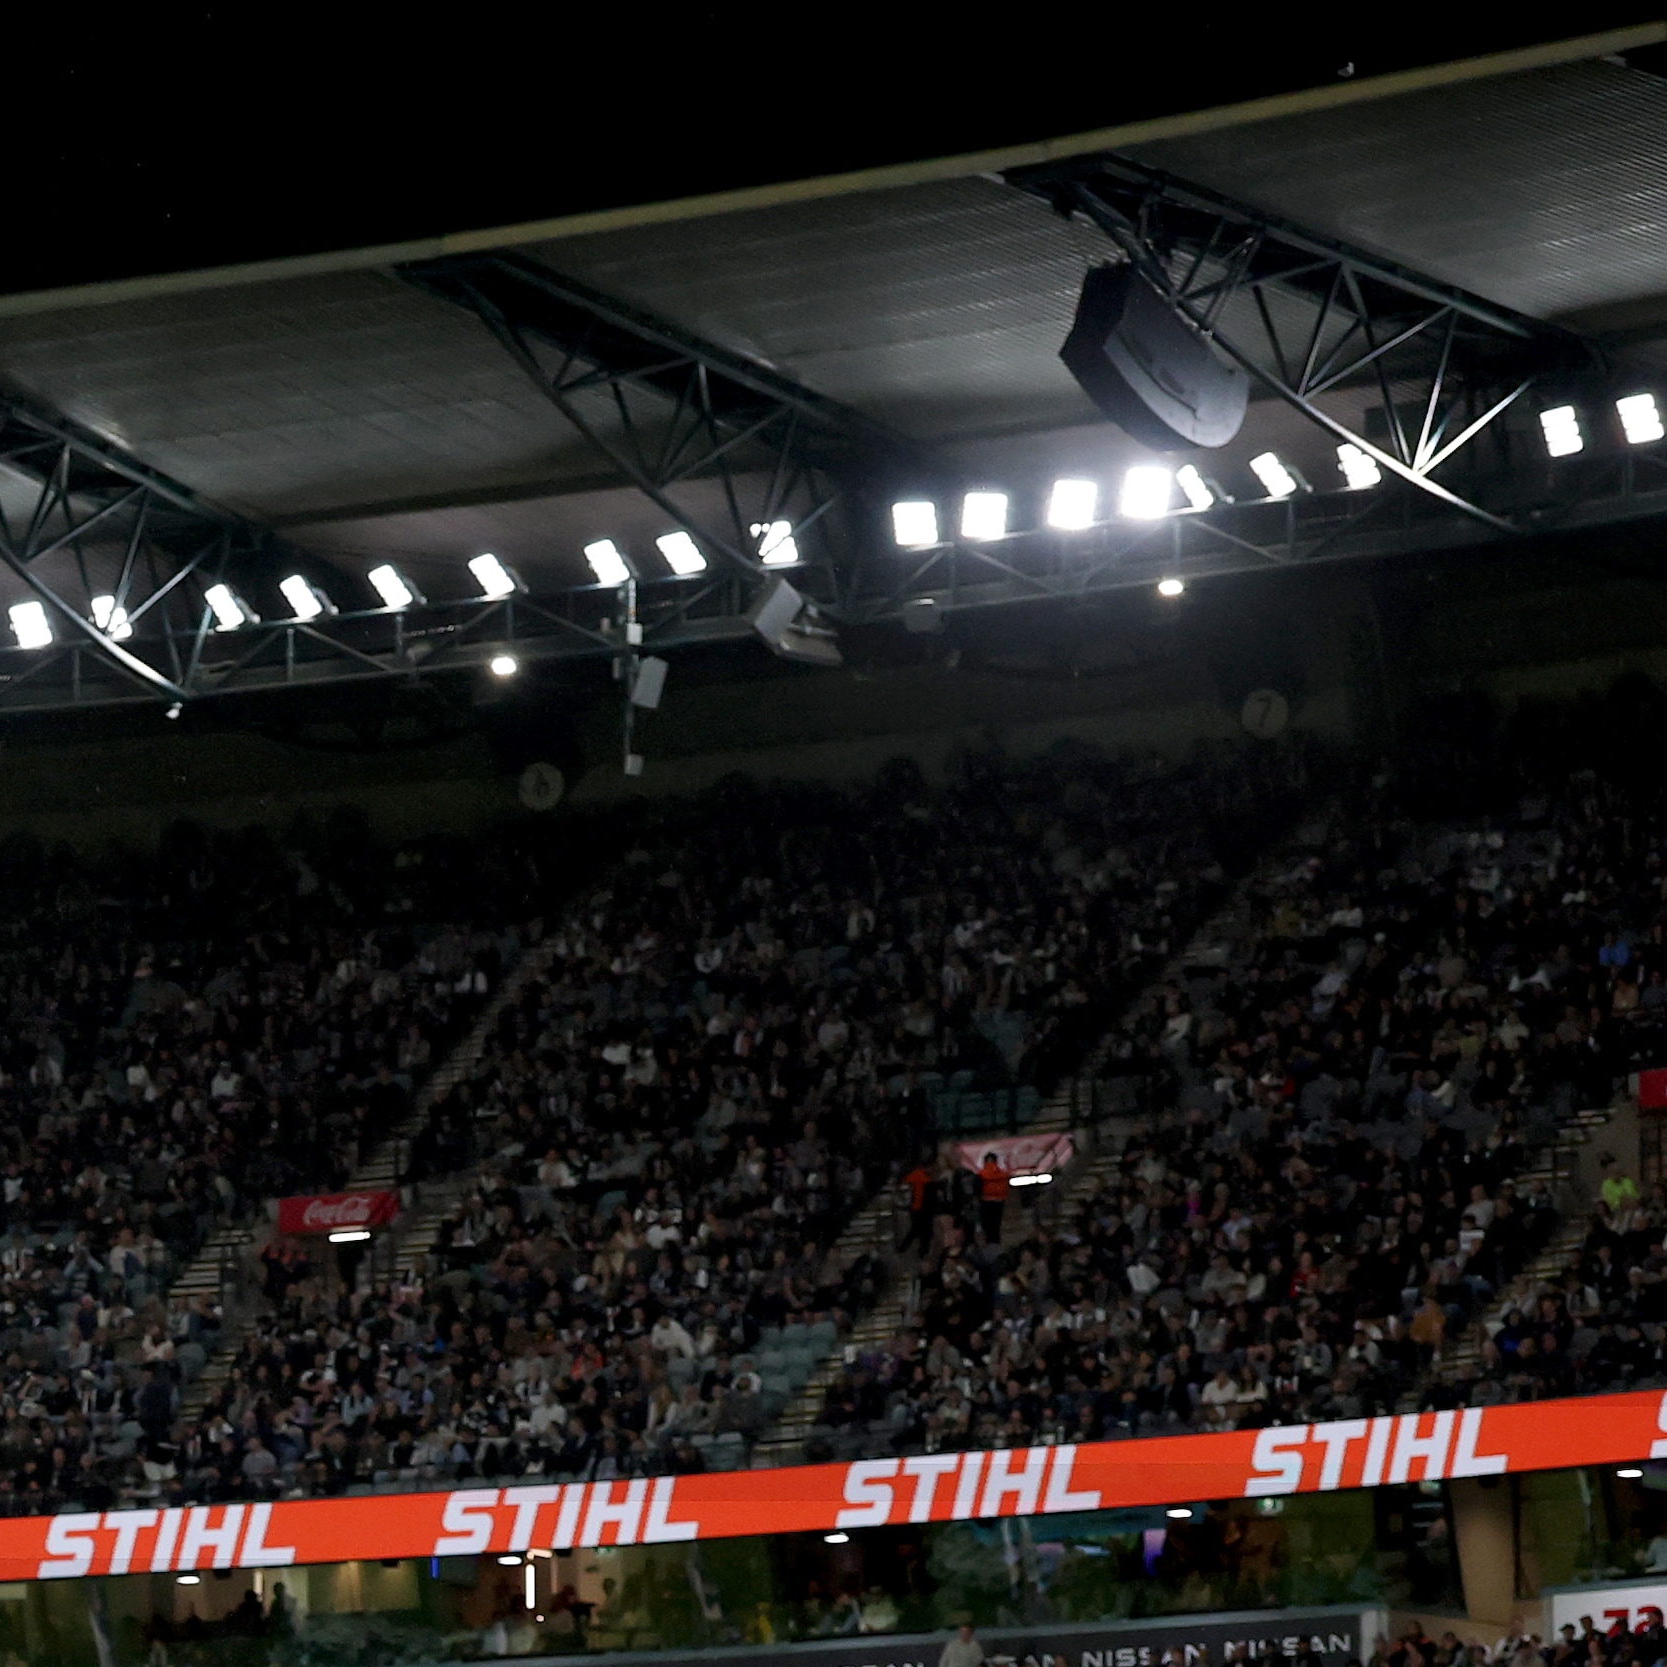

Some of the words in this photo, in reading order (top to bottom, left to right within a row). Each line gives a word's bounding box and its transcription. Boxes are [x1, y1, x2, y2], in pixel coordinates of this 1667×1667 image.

[39, 1503, 295, 1577] STIHL
[434, 1477, 698, 1555] STIHL
[836, 1445, 1100, 1528] STIHL
[1245, 1408, 1507, 1496] STIHL
